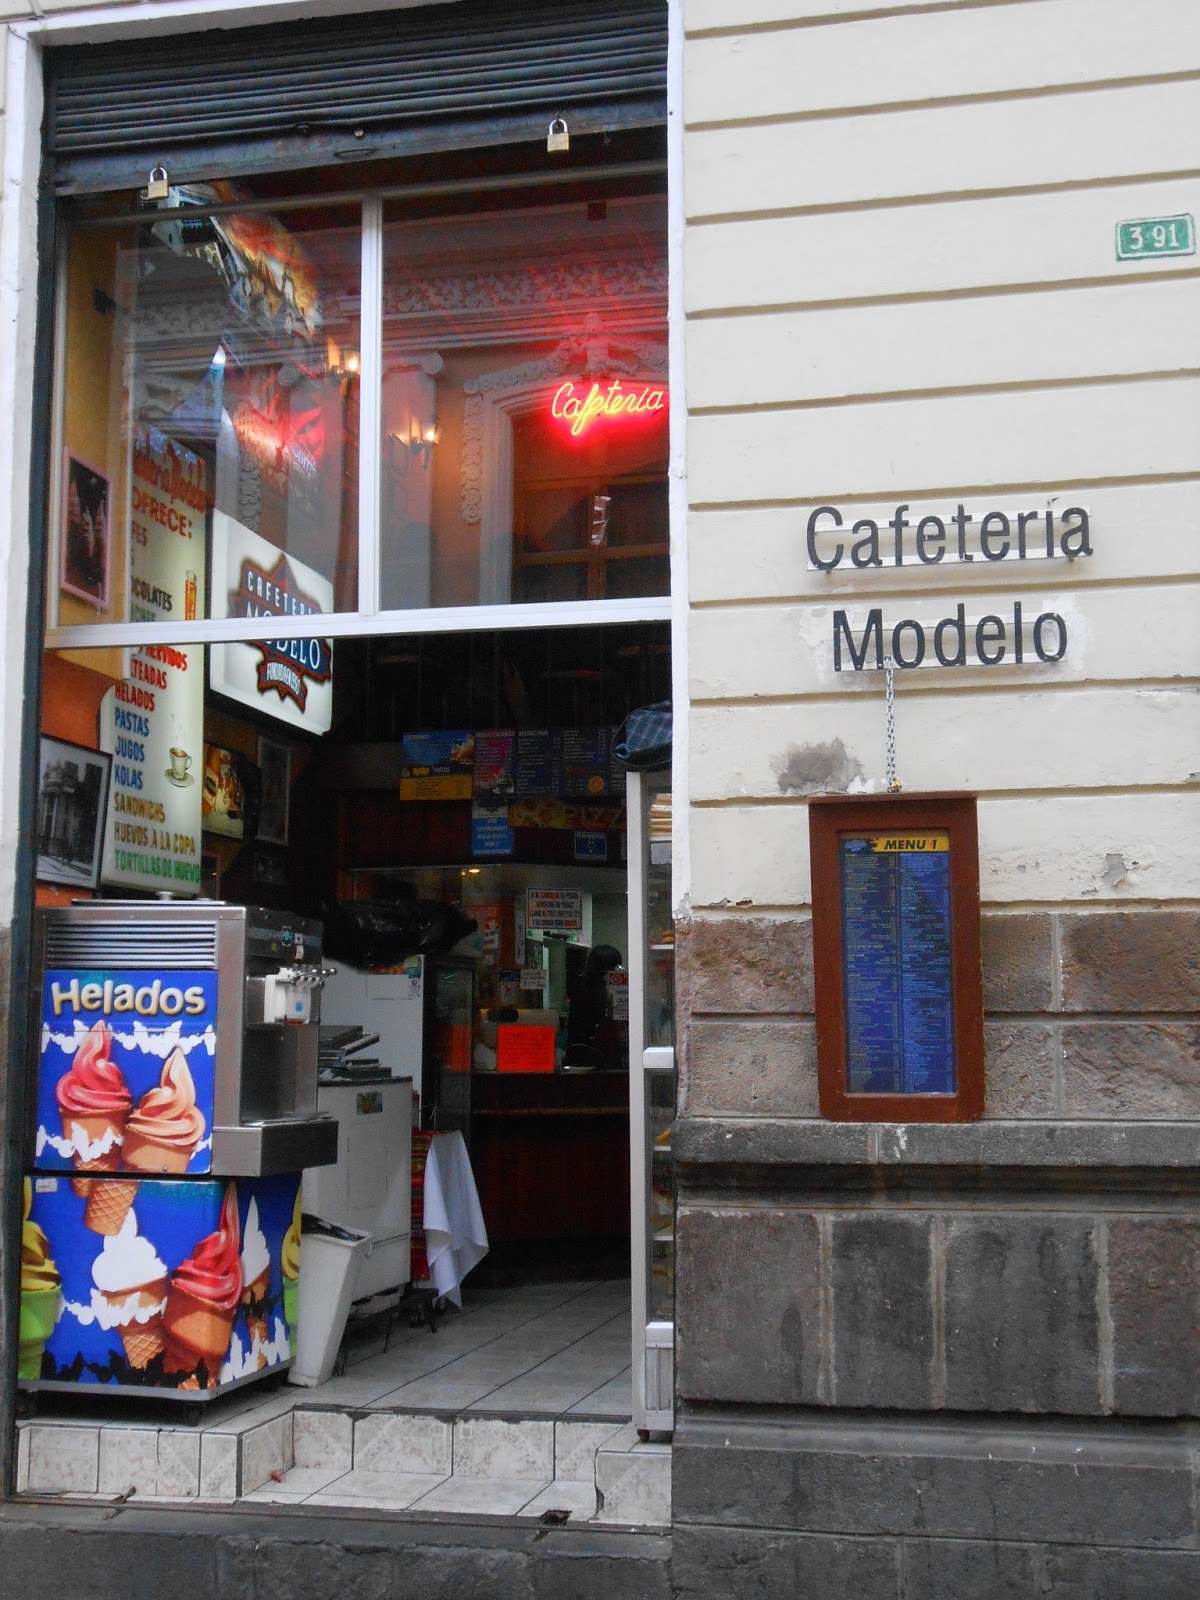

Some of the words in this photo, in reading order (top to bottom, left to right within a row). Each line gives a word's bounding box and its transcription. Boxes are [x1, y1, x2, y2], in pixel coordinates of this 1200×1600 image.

[247, 570, 319, 616] CAFETER
[833, 602, 1067, 672] Modelo
[131, 657, 167, 690] TEADAS
[114, 681, 156, 712] HELADOS
[114, 706, 150, 737] PASTAS
[114, 735, 146, 762] JUGOS
[114, 763, 144, 790] KOLAS
[114, 820, 149, 847] HUEVOS
[151, 828, 158, 849] A
[160, 830, 171, 851] LA
[173, 832, 196, 856] COPA
[884, 839, 926, 850] MENU
[114, 848, 161, 876] TORTILLAS
[161, 857, 173, 878] DE
[51, 978, 206, 1016] Helados
